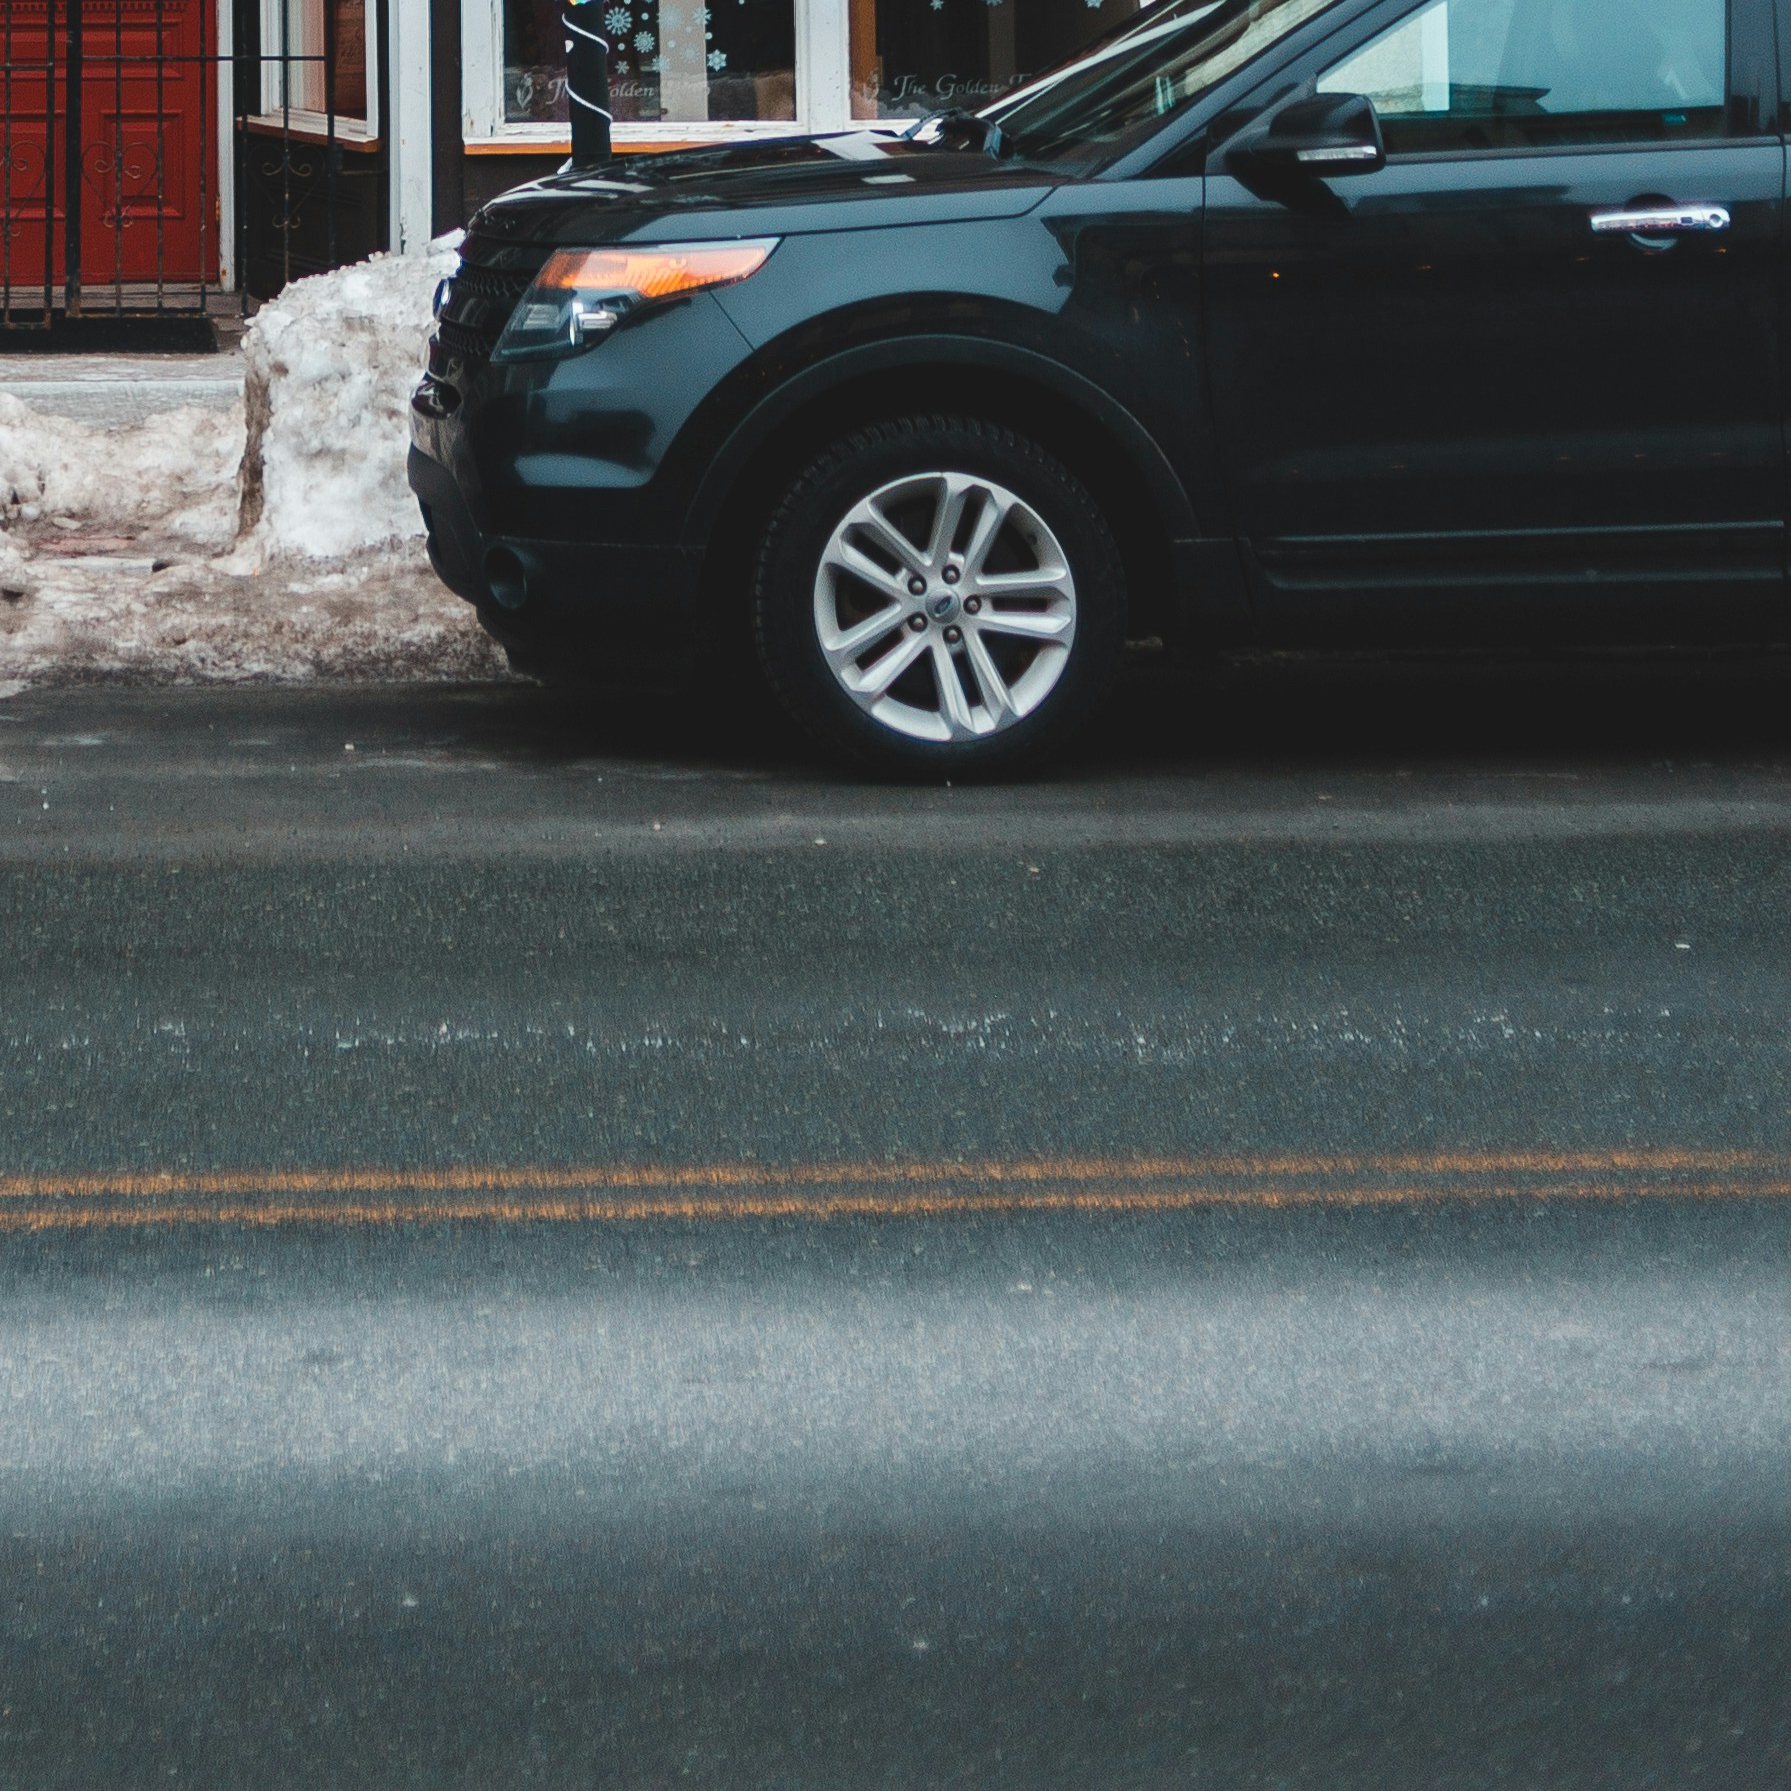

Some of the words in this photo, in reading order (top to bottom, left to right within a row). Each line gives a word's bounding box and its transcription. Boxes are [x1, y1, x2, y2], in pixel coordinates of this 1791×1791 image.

[606, 77, 655, 98] olden
[891, 73, 928, 102] The
[936, 72, 1005, 101] Golden
